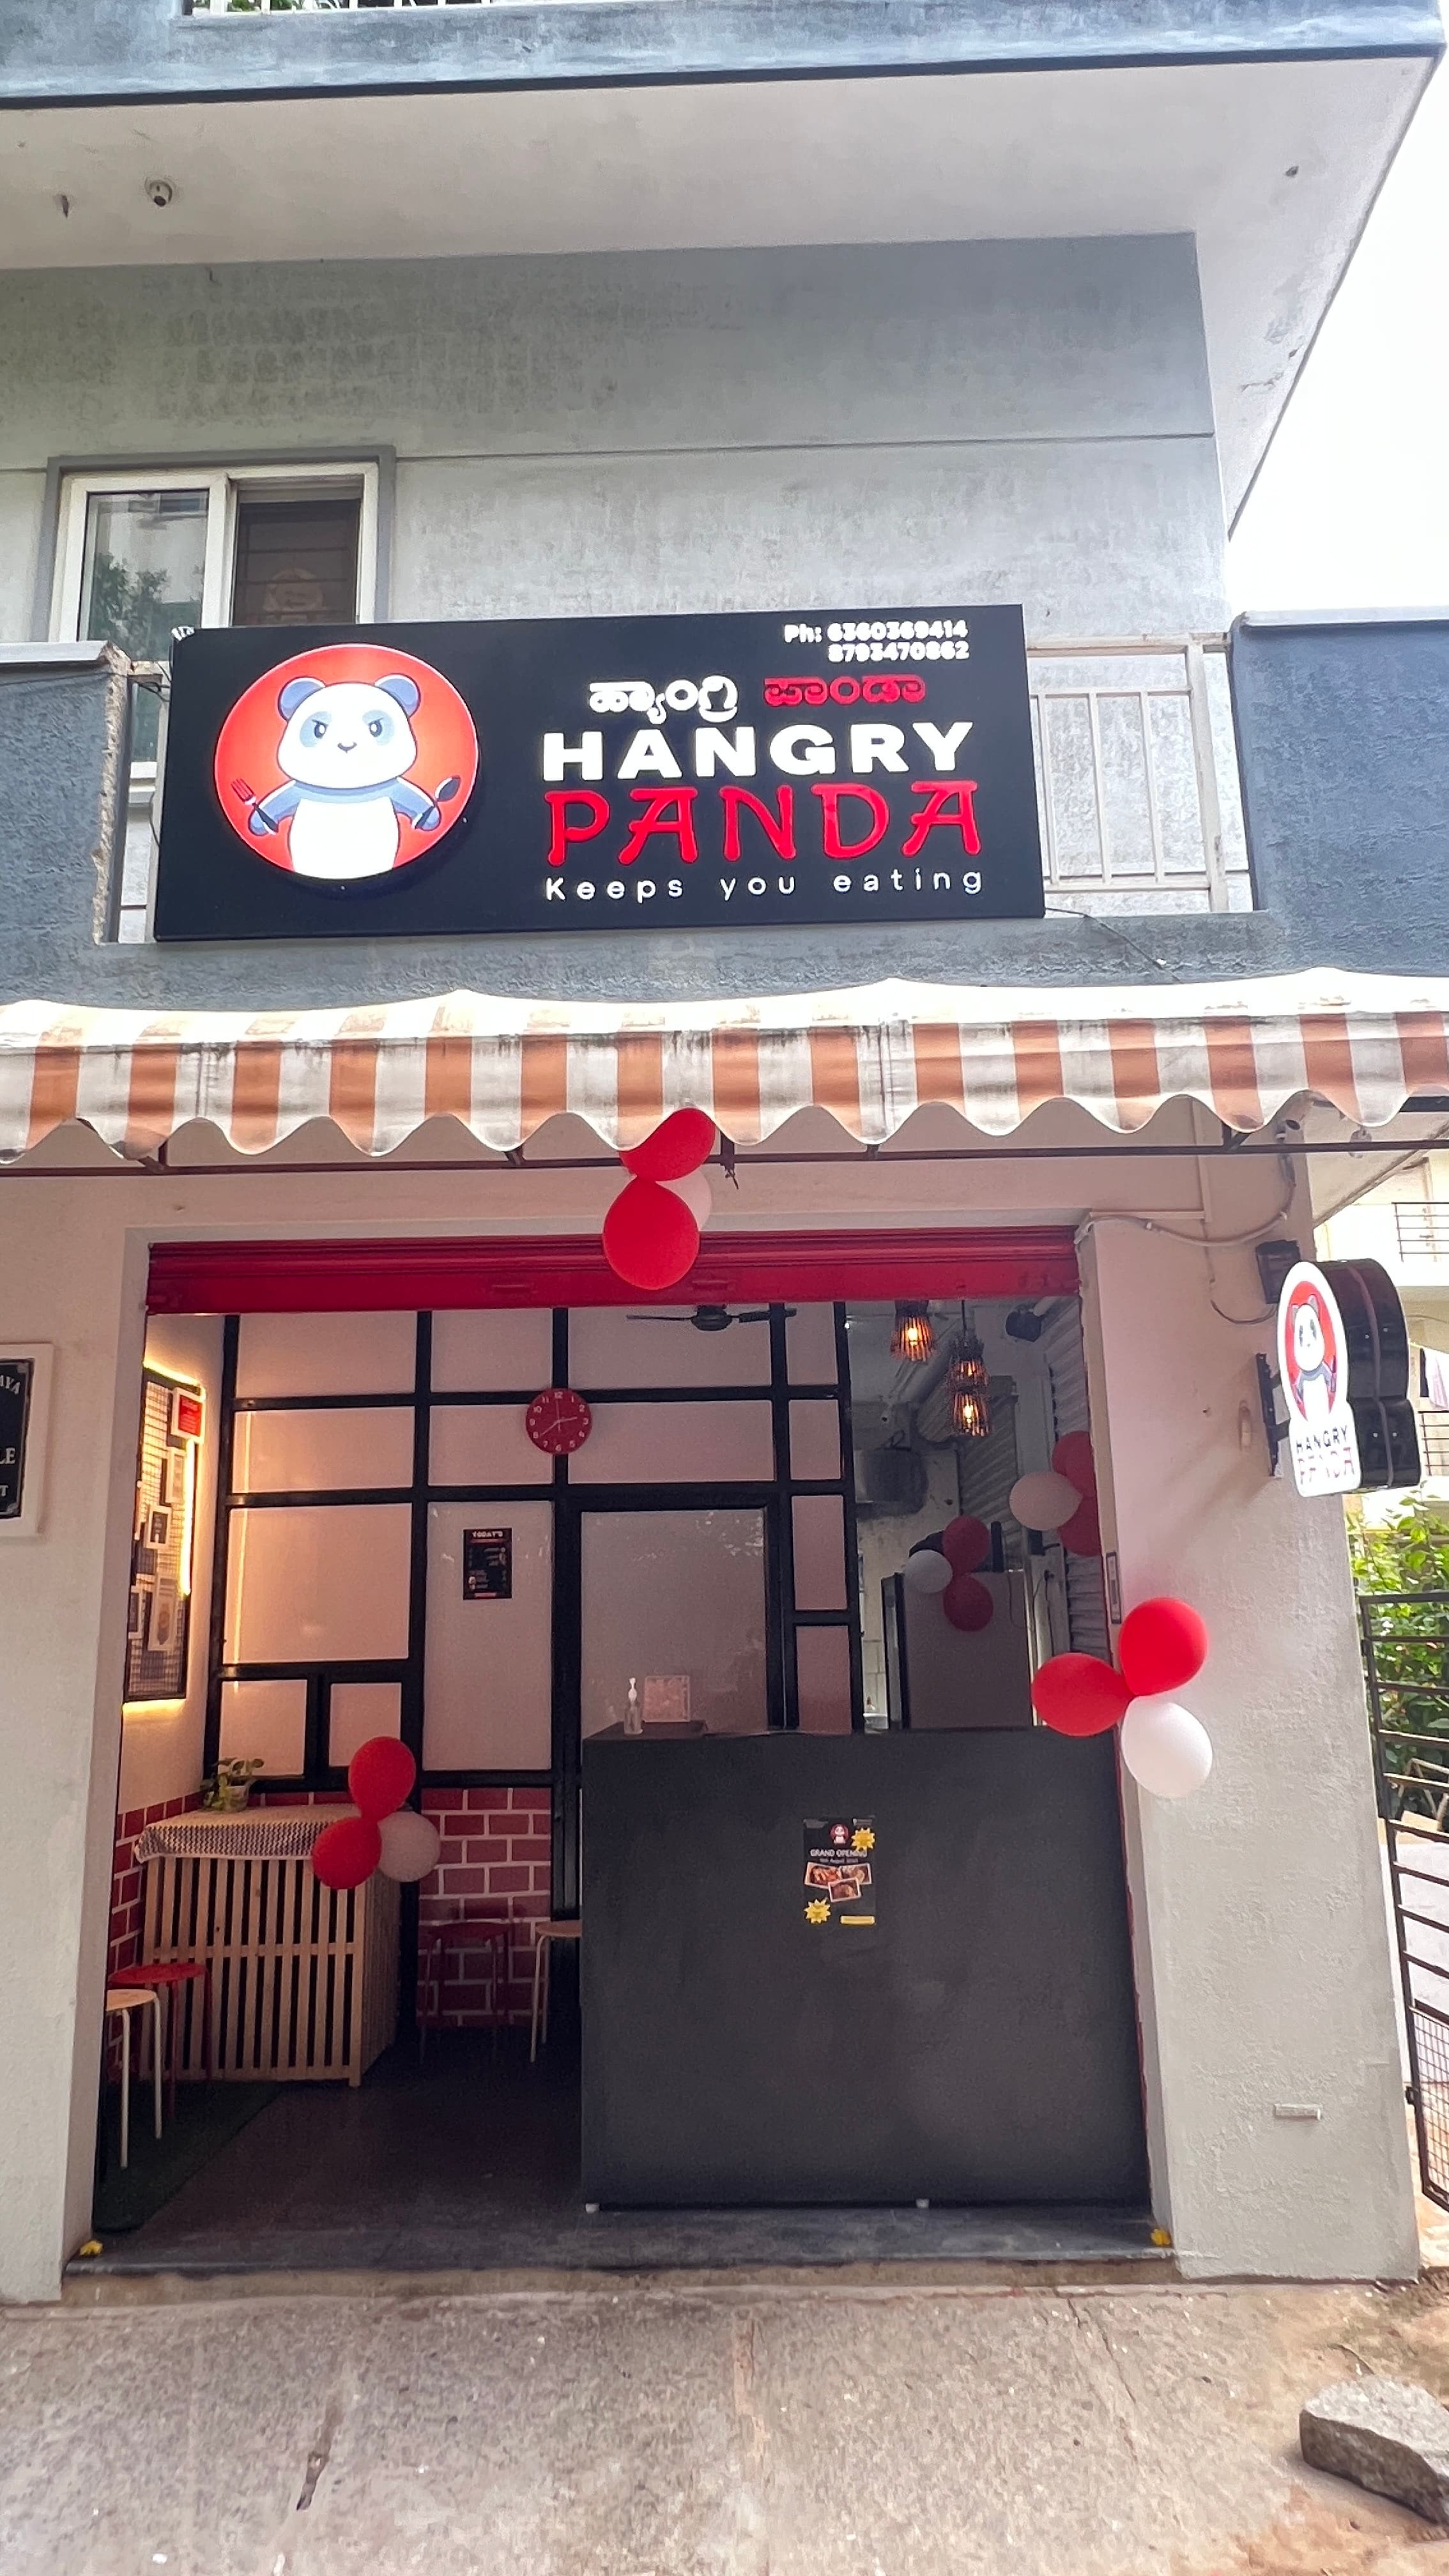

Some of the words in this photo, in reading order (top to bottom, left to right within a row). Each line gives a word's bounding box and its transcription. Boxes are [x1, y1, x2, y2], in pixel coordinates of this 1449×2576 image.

[785, 624, 822, 643] Ph:
[543, 721, 973, 781] HANGRY
[544, 780, 981, 866] PANDA
[546, 877, 683, 903] Keeps
[720, 877, 795, 901] you
[833, 868, 982, 894] eating
[1296, 1425, 1347, 1455] HANGRY
[1298, 1446, 1354, 1485] PADA
